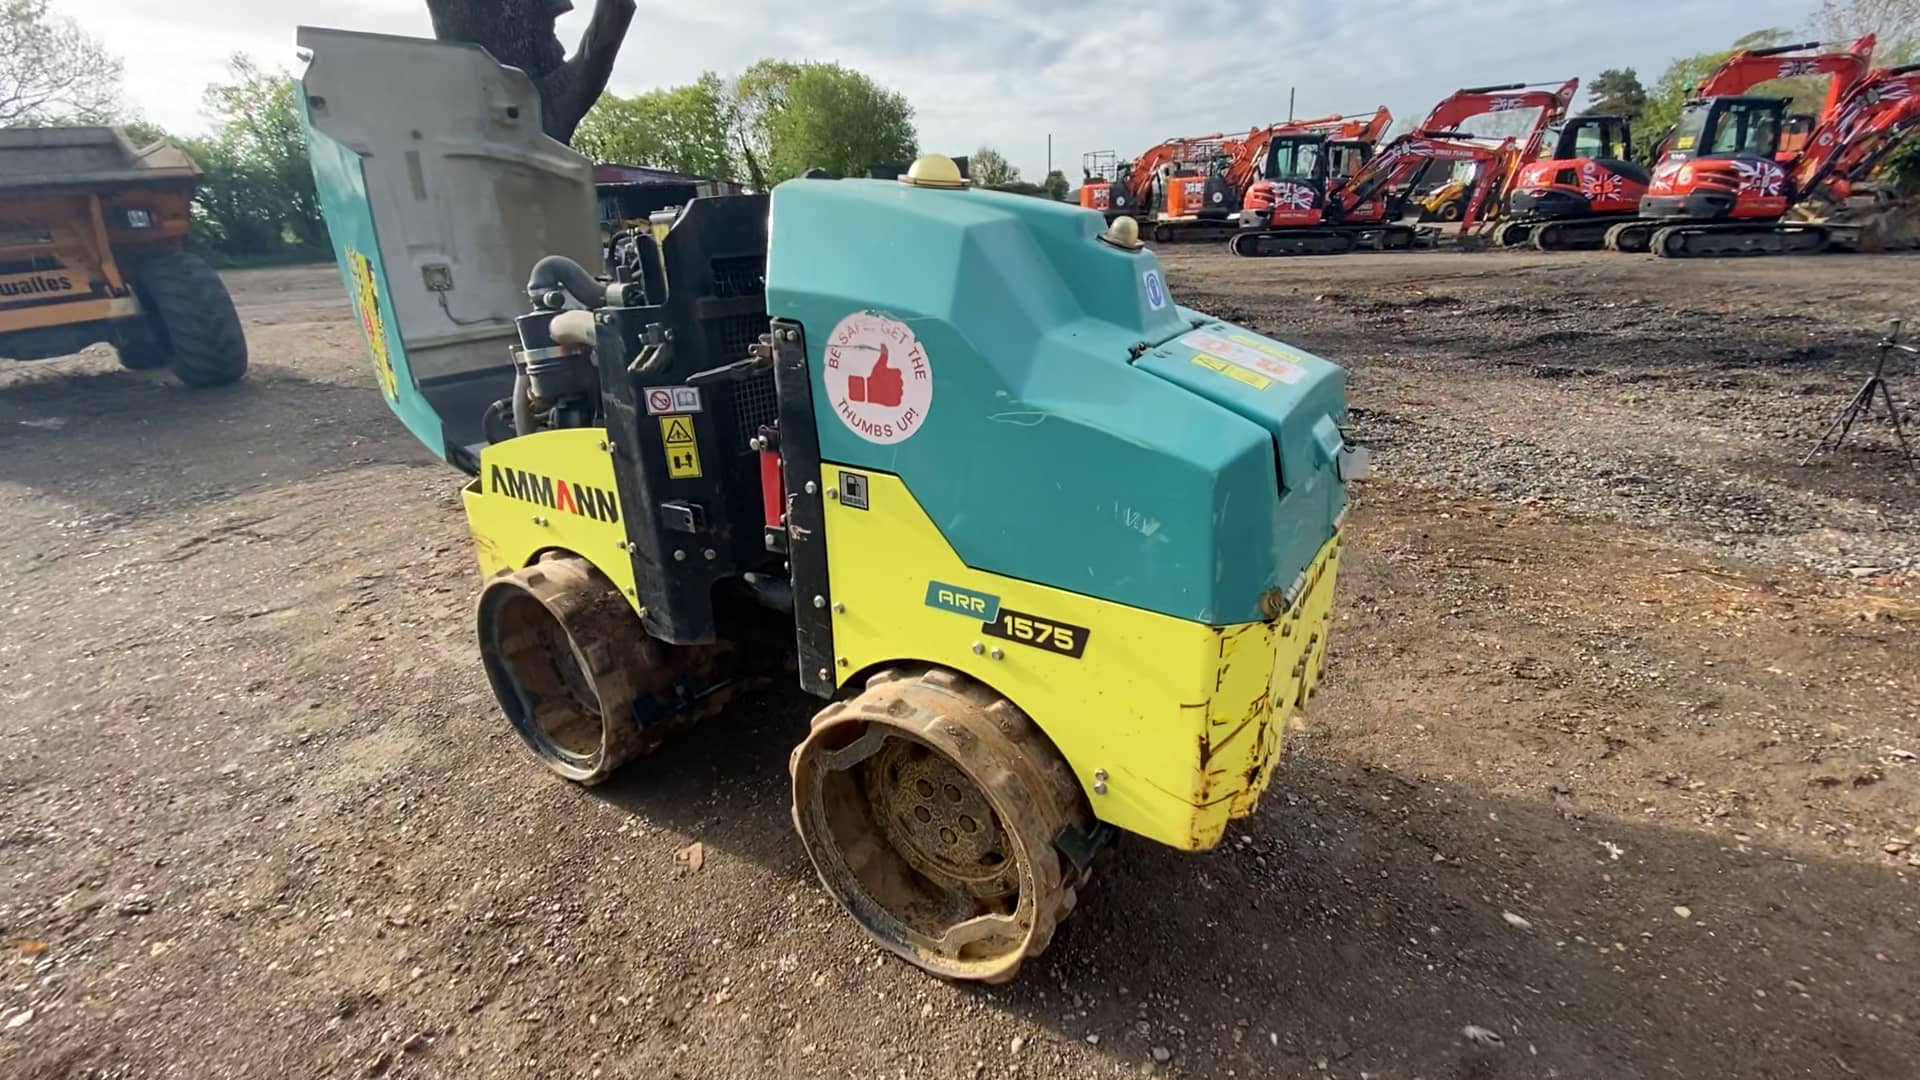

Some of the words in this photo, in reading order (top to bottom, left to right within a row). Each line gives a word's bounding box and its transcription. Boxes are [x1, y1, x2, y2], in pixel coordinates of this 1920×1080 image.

[828, 347, 842, 370] BE
[880, 322, 909, 345] GET
[907, 347, 927, 381] THE
[838, 397, 893, 438] THUMBS
[896, 407, 919, 432] UP!
[491, 463, 620, 524] AMMANN
[938, 589, 986, 613] ARR
[1003, 615, 1074, 650] 1575
